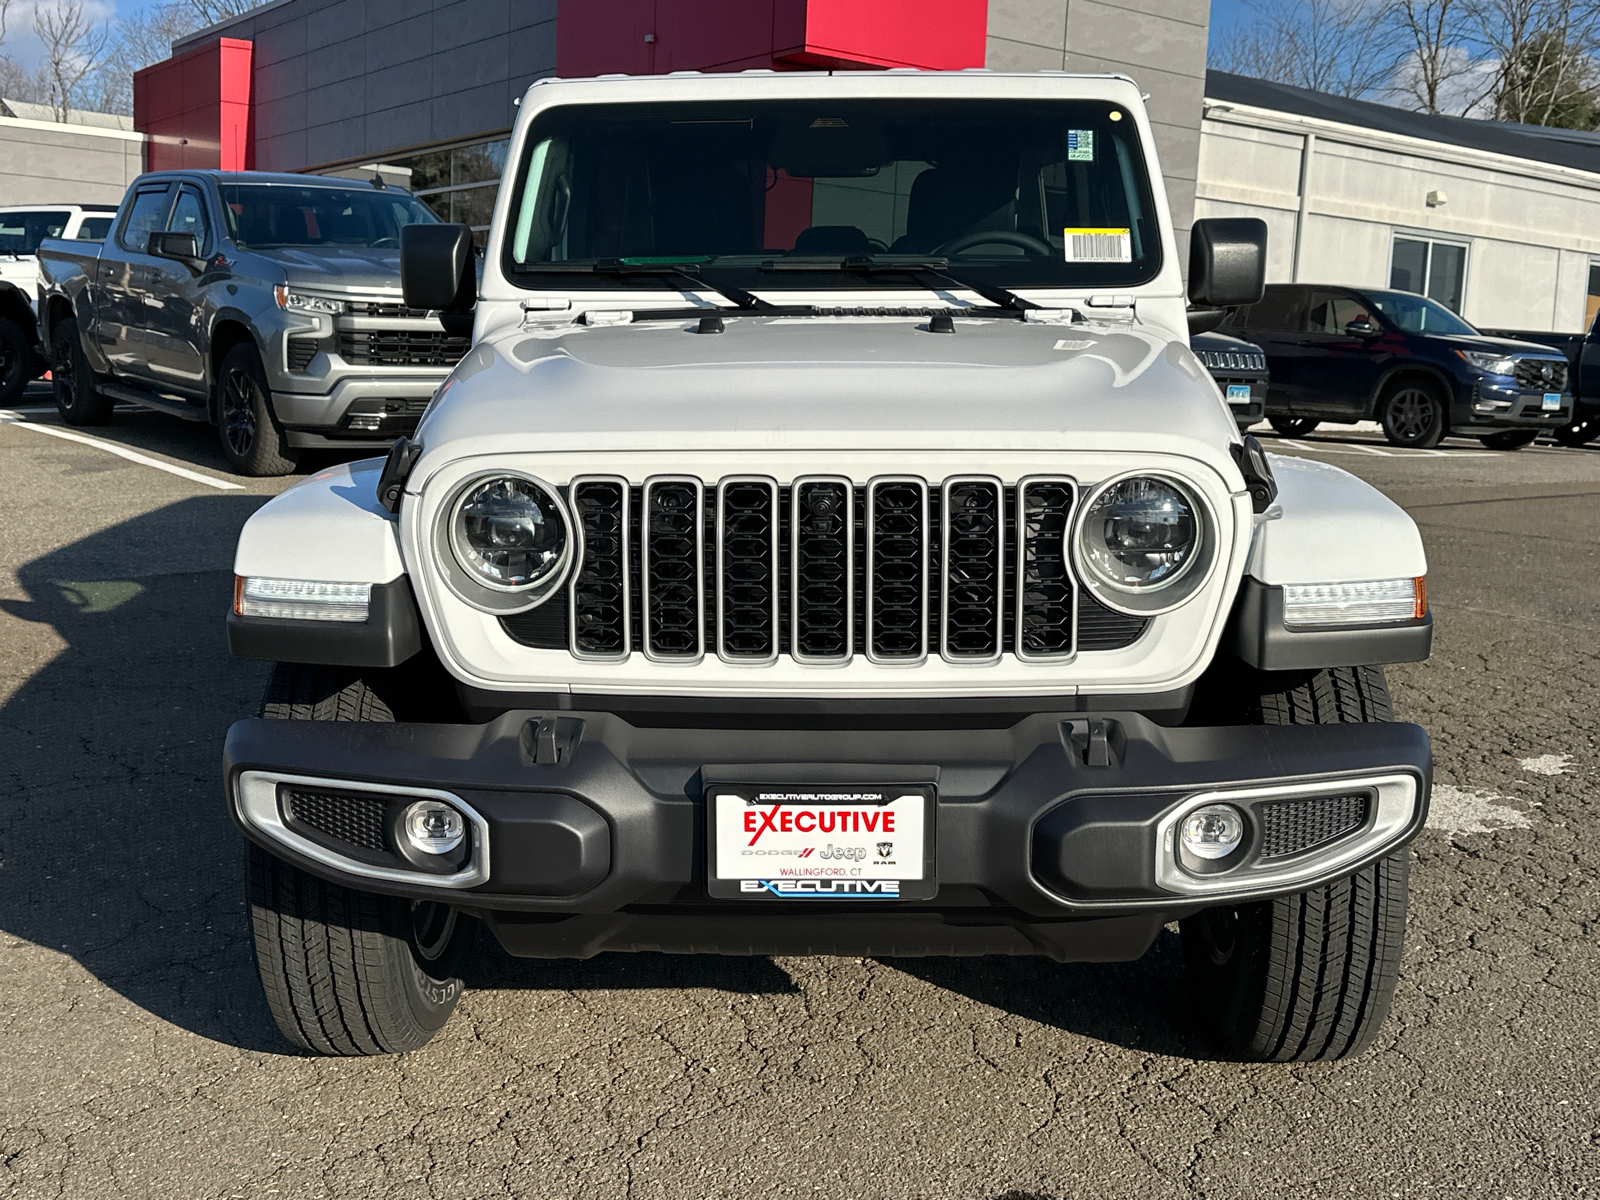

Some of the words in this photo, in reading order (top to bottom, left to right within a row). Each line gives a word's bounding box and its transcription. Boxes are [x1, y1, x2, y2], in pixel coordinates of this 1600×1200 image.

[744, 805, 895, 845] EXECUTIVE
[819, 844, 867, 862] Jeep
[780, 868, 848, 877] WALLINGFORD,
[850, 868, 862, 877] CT
[740, 880, 900, 895] EXECUTIVE
